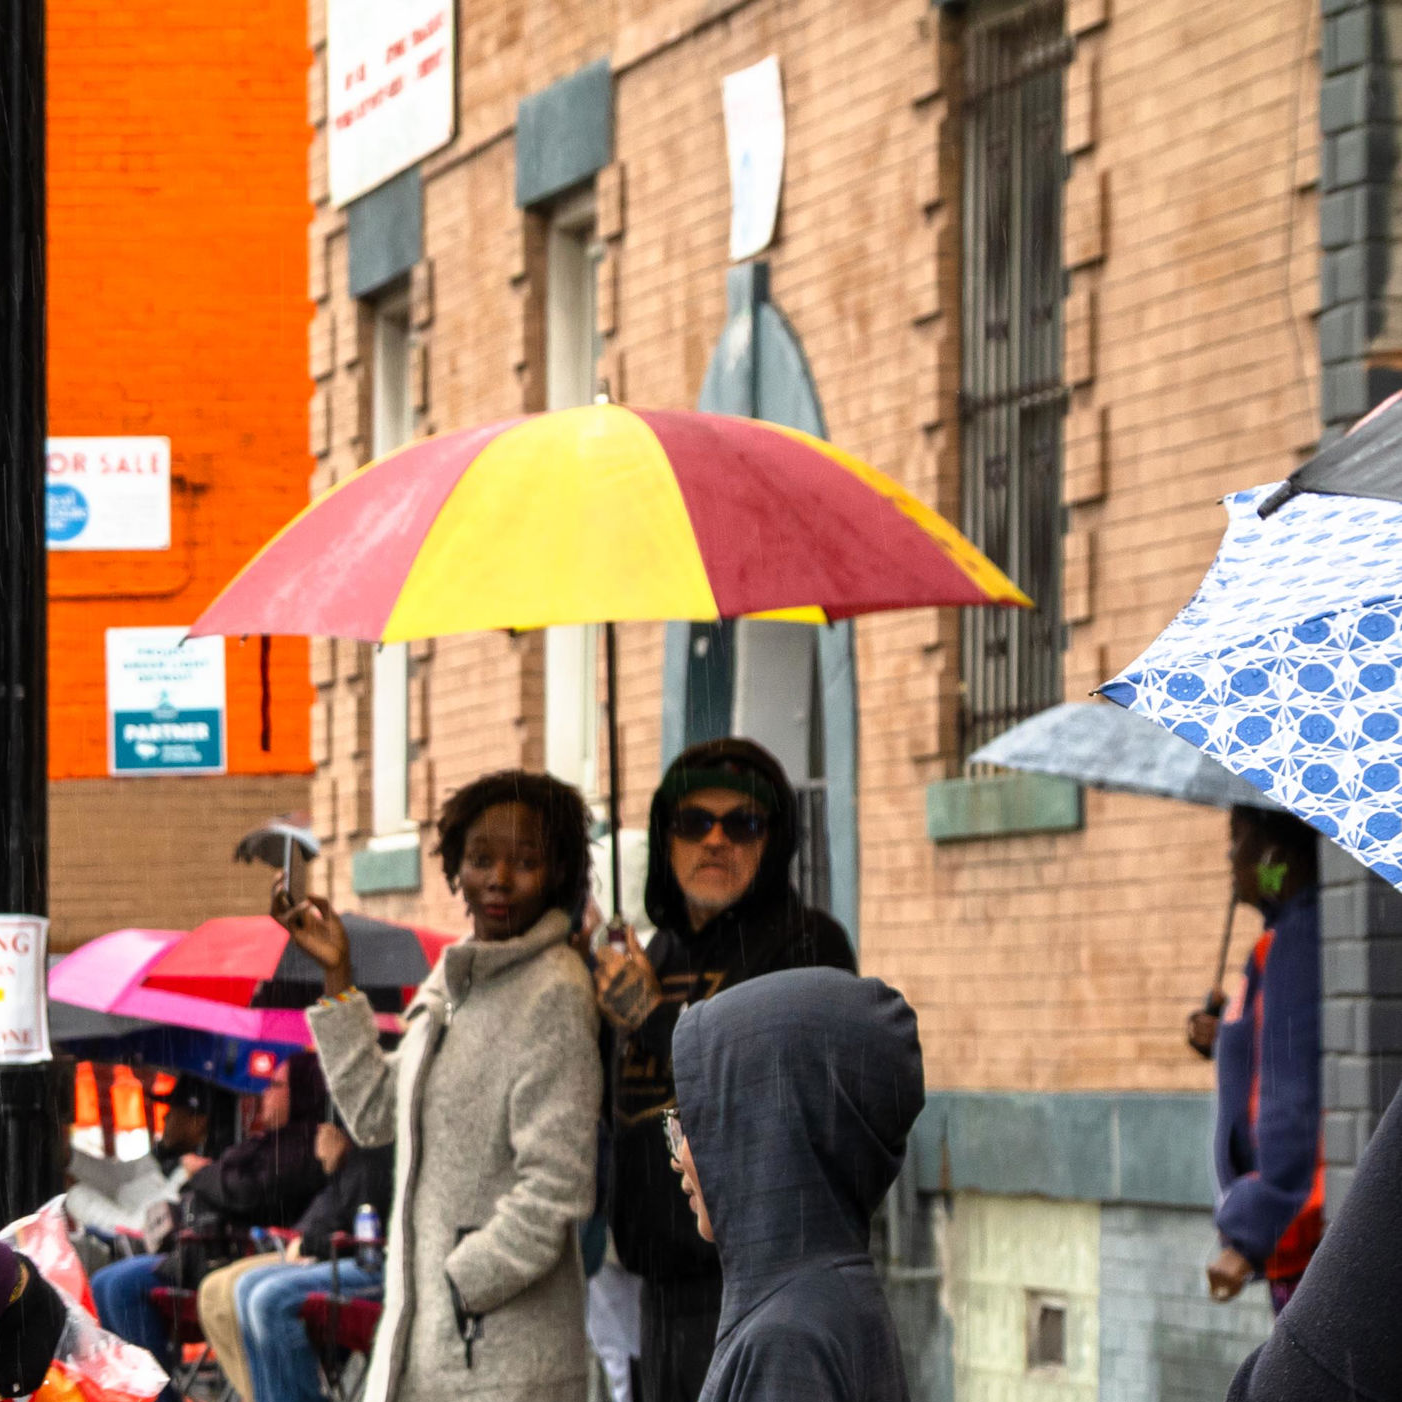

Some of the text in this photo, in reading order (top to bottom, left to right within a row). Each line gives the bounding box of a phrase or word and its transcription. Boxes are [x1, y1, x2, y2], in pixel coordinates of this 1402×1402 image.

[47, 452, 161, 476] OR SALE
[123, 722, 210, 742] PARTNER
